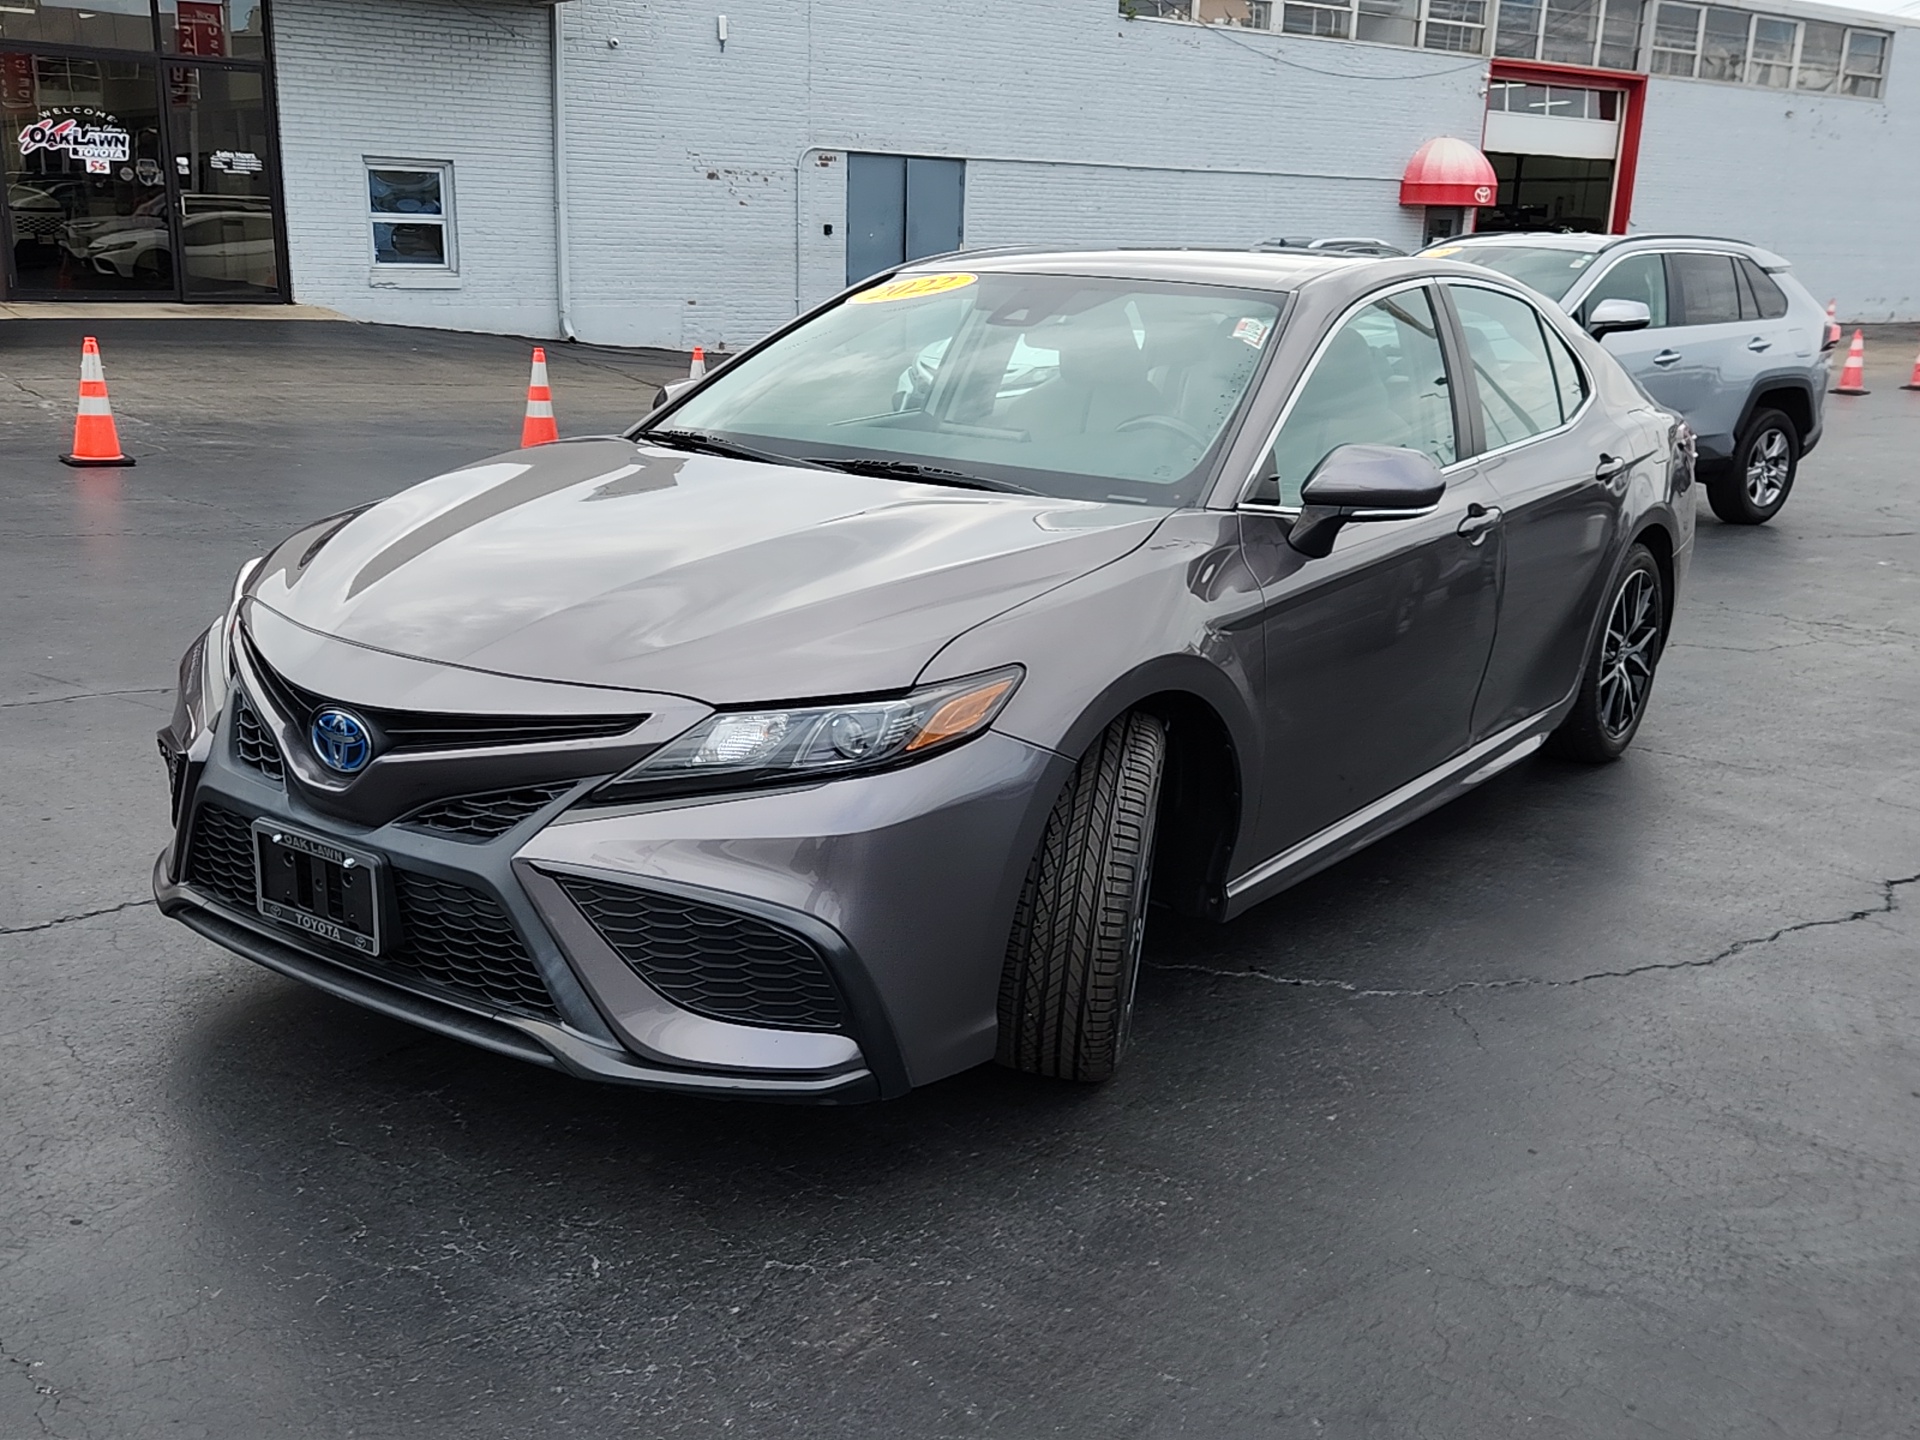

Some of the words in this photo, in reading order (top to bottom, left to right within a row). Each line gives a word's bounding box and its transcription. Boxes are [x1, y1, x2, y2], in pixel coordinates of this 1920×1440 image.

[38, 106, 118, 122] WELCOME
[78, 148, 124, 158] TOYOTA
[284, 834, 309, 849] OAK
[310, 842, 343, 861] LAWN
[295, 913, 341, 940] TOYOTA
